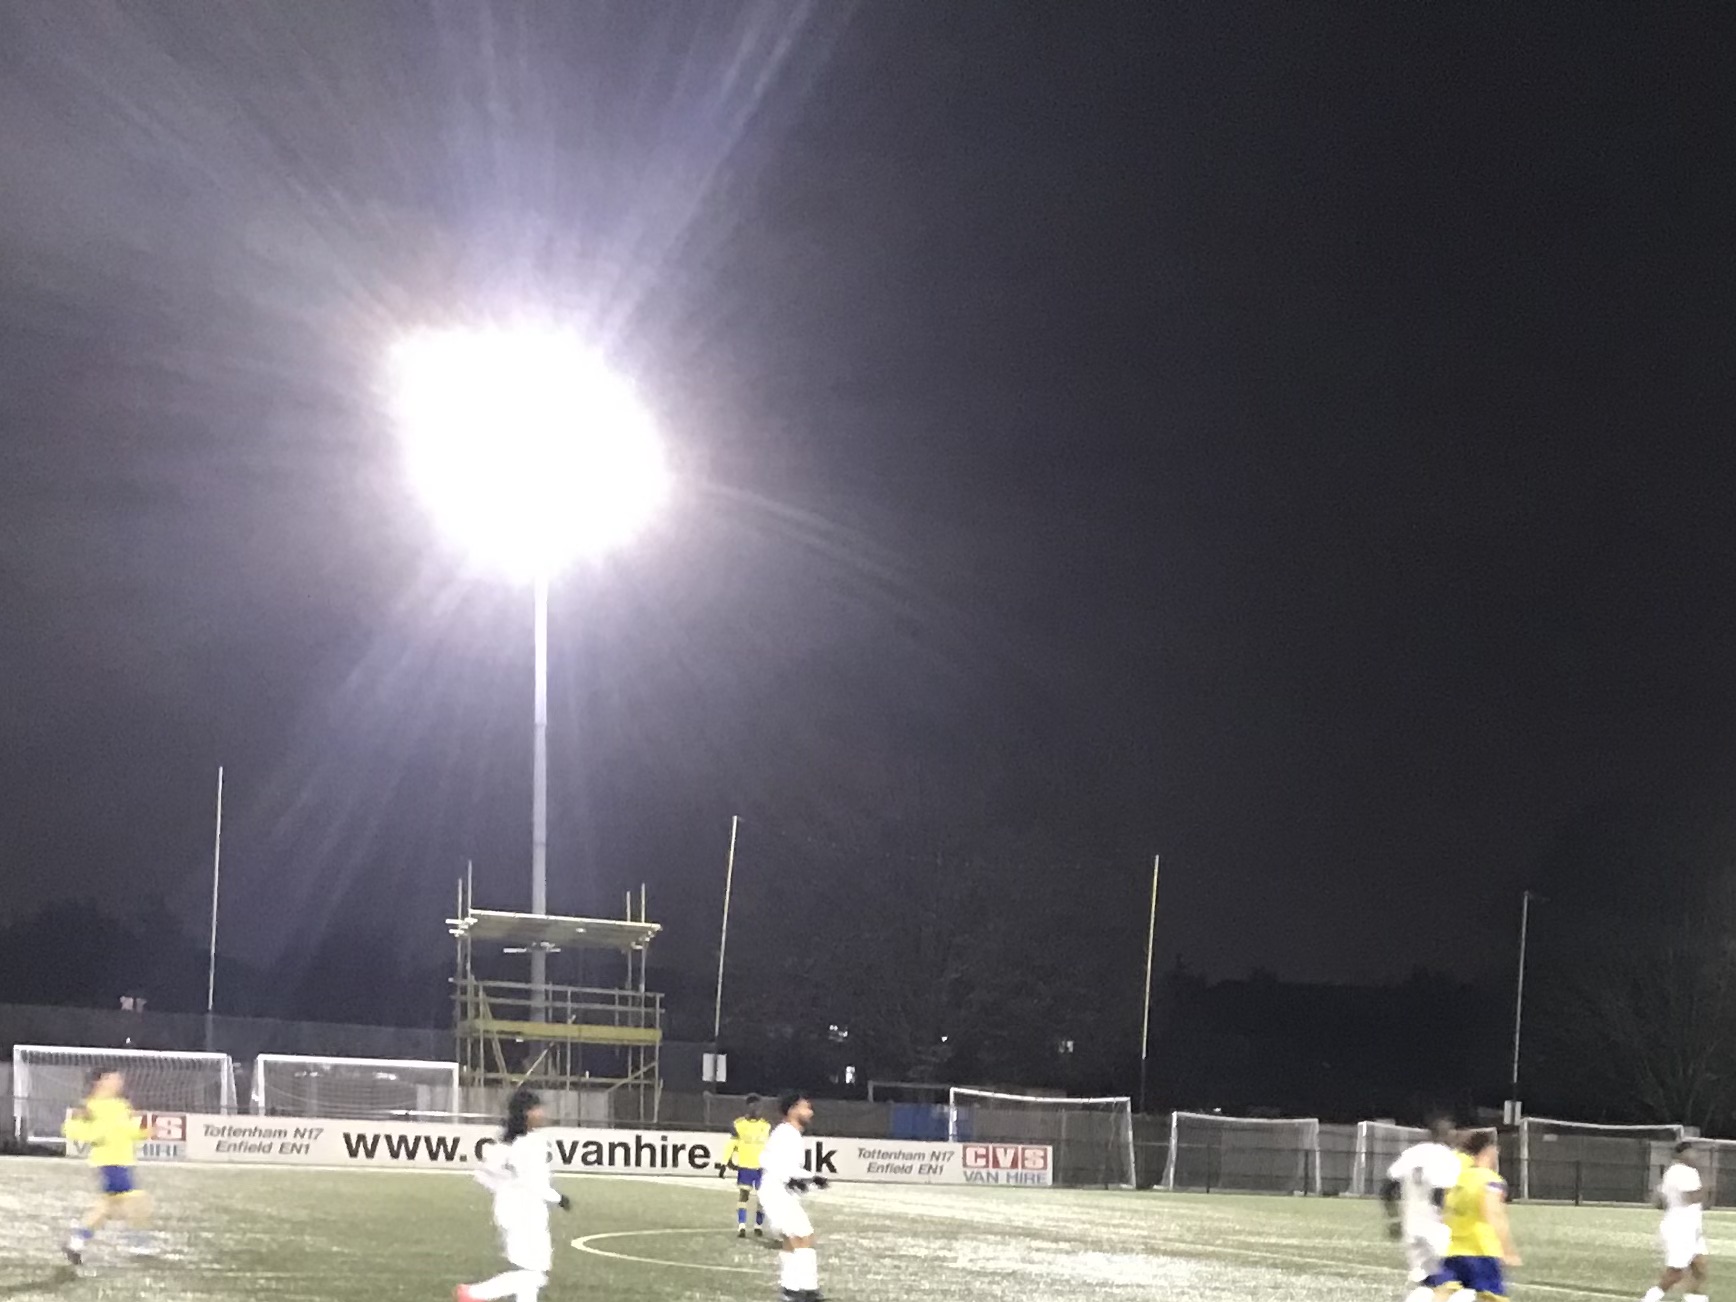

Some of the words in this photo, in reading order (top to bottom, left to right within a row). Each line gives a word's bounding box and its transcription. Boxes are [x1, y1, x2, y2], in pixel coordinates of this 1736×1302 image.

[203, 1124, 288, 1139] Tottenham
[293, 1127, 324, 1140] N17
[215, 1140, 272, 1154] Enfield
[278, 1142, 310, 1155] EN1
[857, 1147, 926, 1161] Tottenham
[930, 1150, 955, 1163] N17
[964, 1145, 1048, 1170] CVS
[867, 1162, 914, 1174] Enfield
[918, 1163, 944, 1176] EN1
[963, 1171, 999, 1183] VAN
[1006, 1172, 1047, 1185] HIRE
